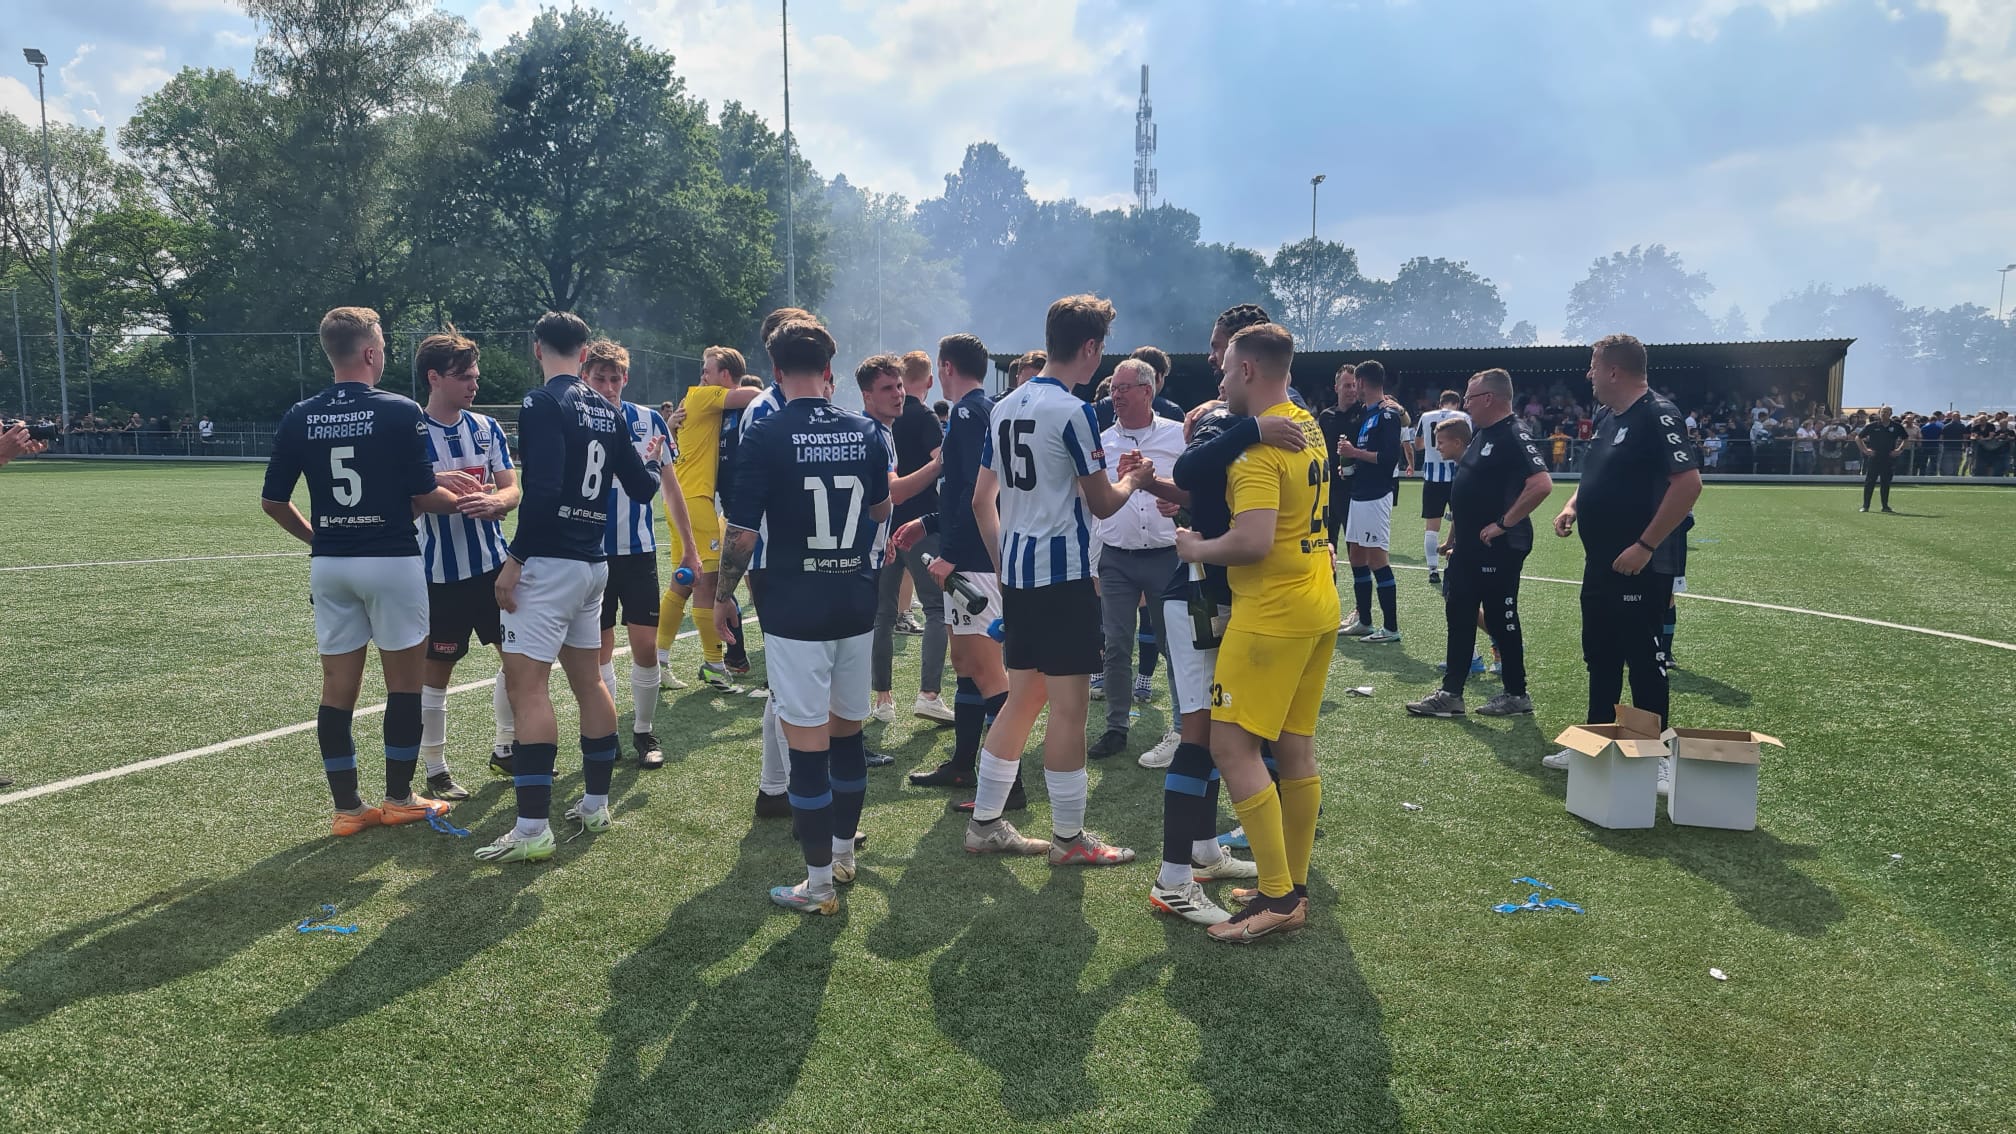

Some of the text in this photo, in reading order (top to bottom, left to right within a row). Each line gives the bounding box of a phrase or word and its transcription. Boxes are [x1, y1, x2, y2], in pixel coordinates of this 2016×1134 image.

[306, 410, 375, 424] SPORTSHOP
[307, 421, 374, 440] LAARBEEK
[791, 431, 865, 445] SPORTSHOP
[796, 444, 867, 463] LAARBEEK
[998, 419, 1036, 491] 15
[330, 446, 362, 508] 5
[581, 439, 606, 501] 8
[804, 475, 864, 550] 17
[1364, 531, 1371, 543] 7
[817, 558, 838, 568] VAN
[951, 608, 960, 626] 3
